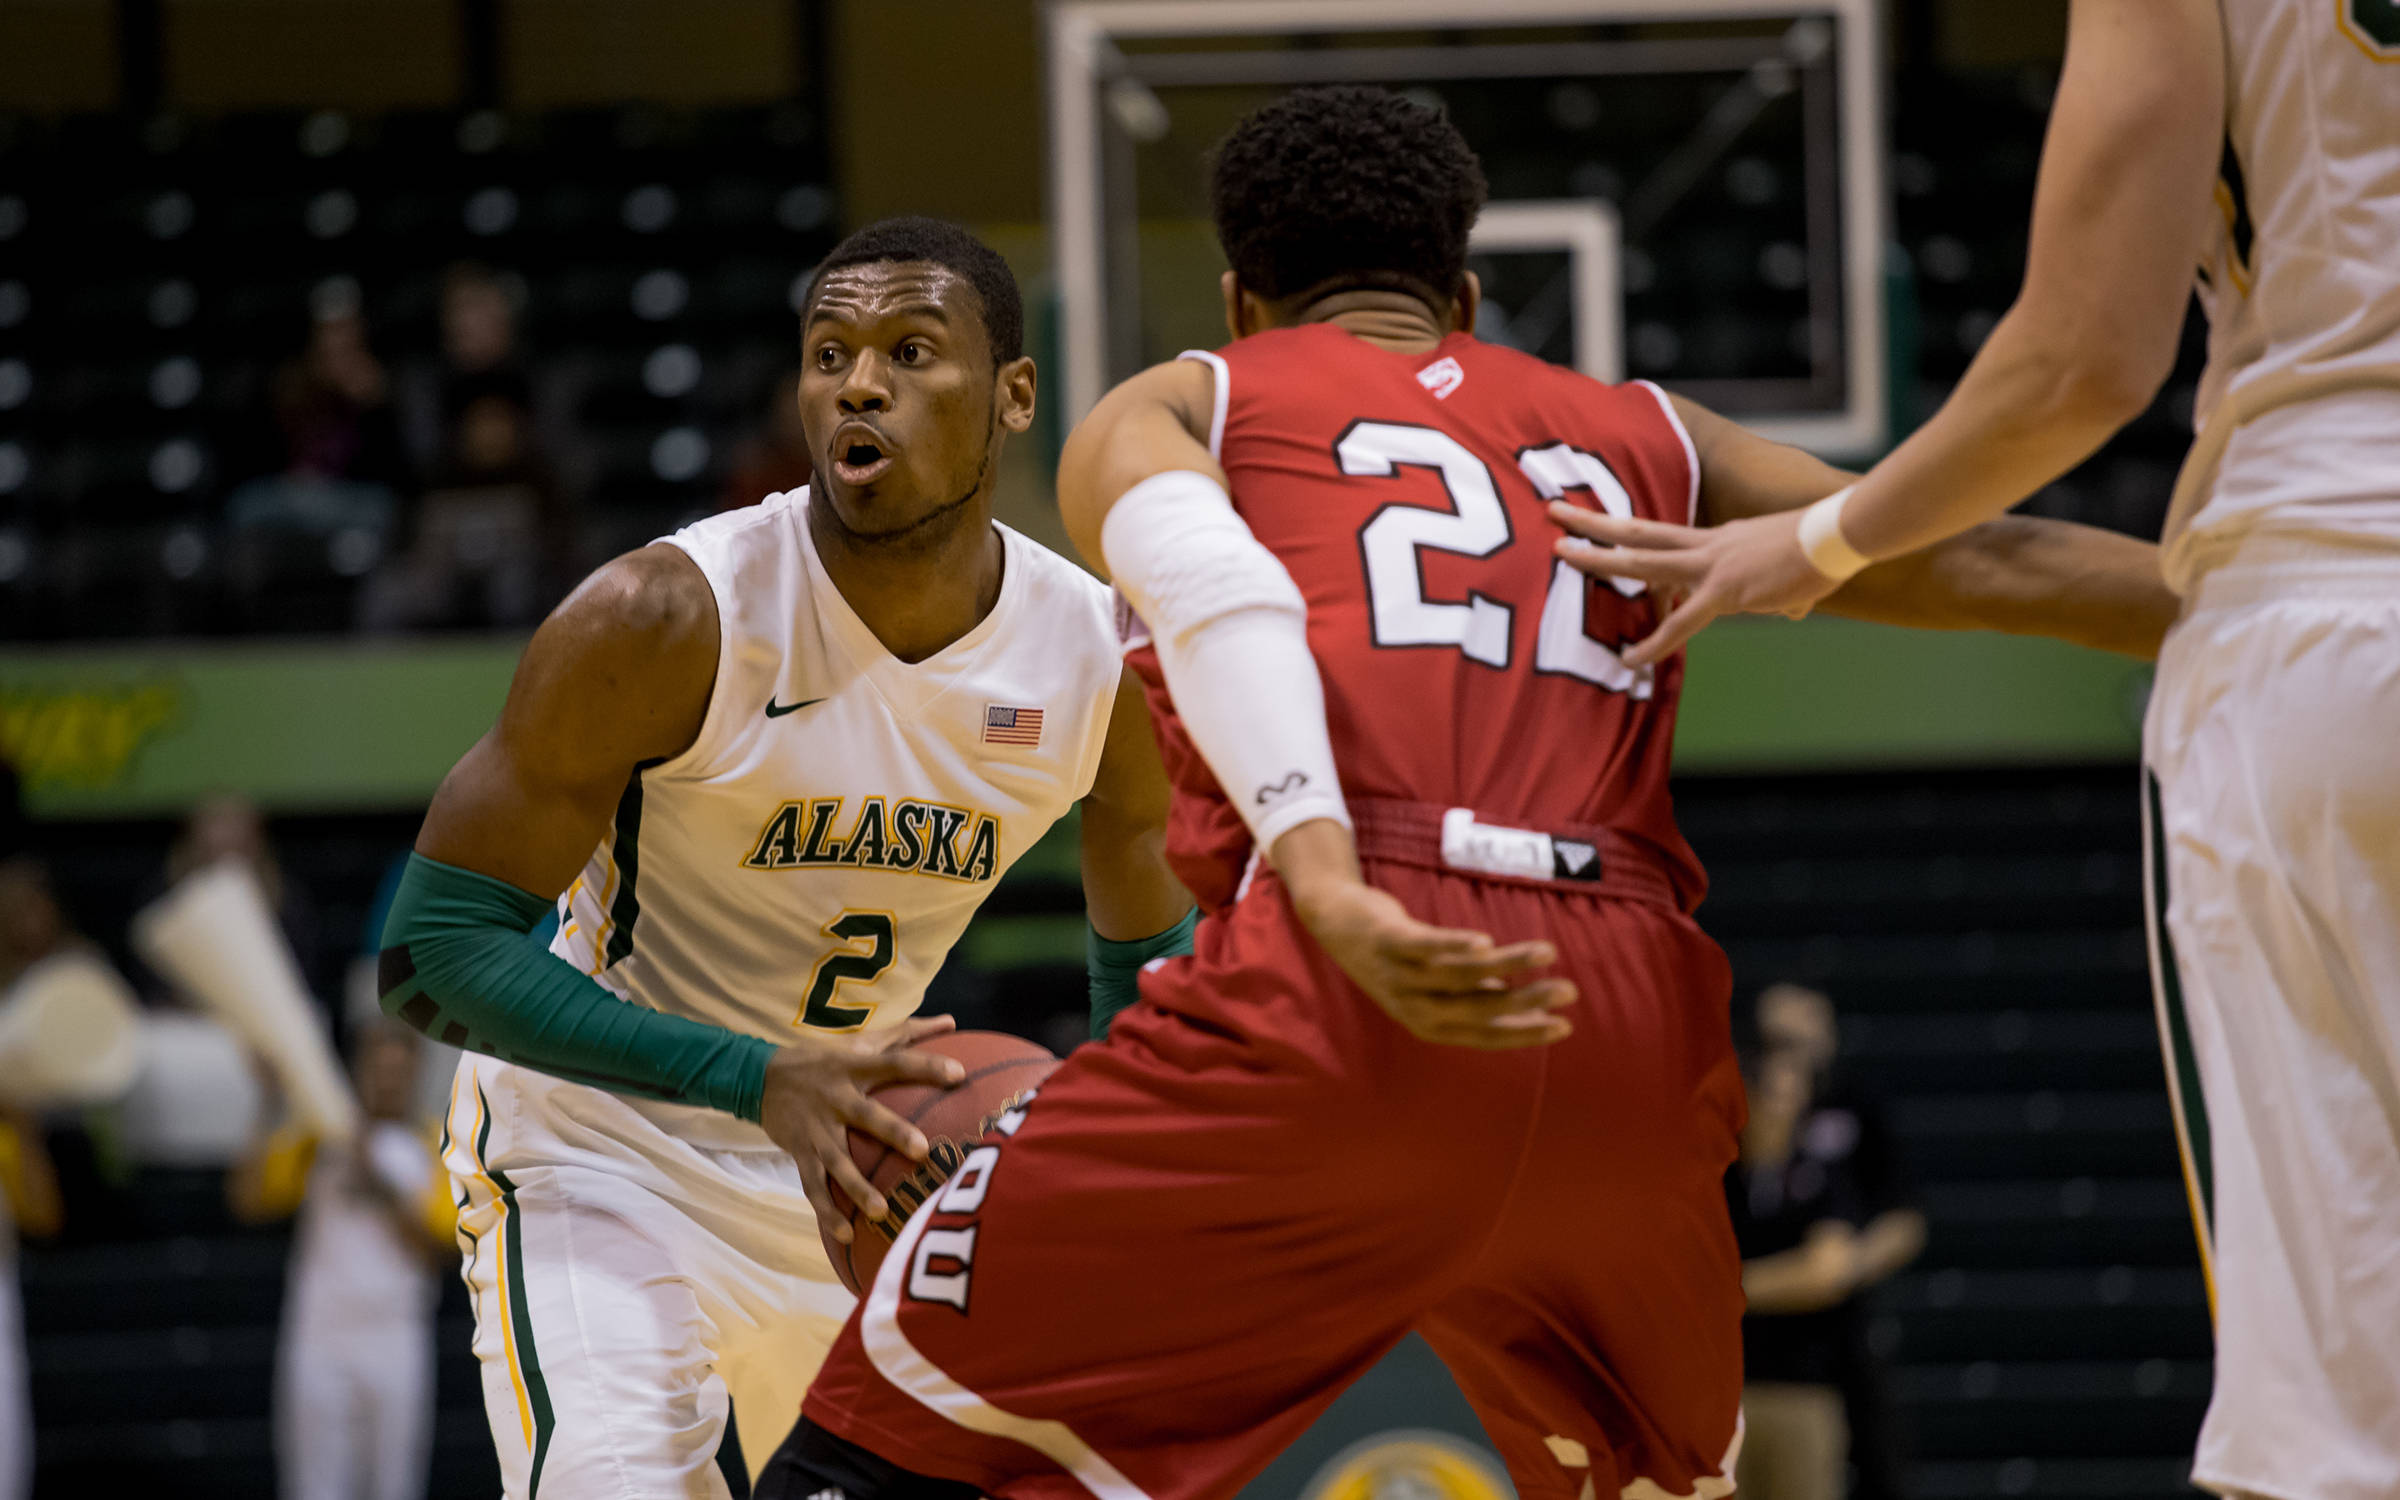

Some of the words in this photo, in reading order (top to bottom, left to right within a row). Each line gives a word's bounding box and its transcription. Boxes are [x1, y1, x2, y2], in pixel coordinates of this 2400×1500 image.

[1332, 417, 1656, 701] 22
[740, 796, 1000, 882] ALASKA
[794, 908, 898, 1034] 2
